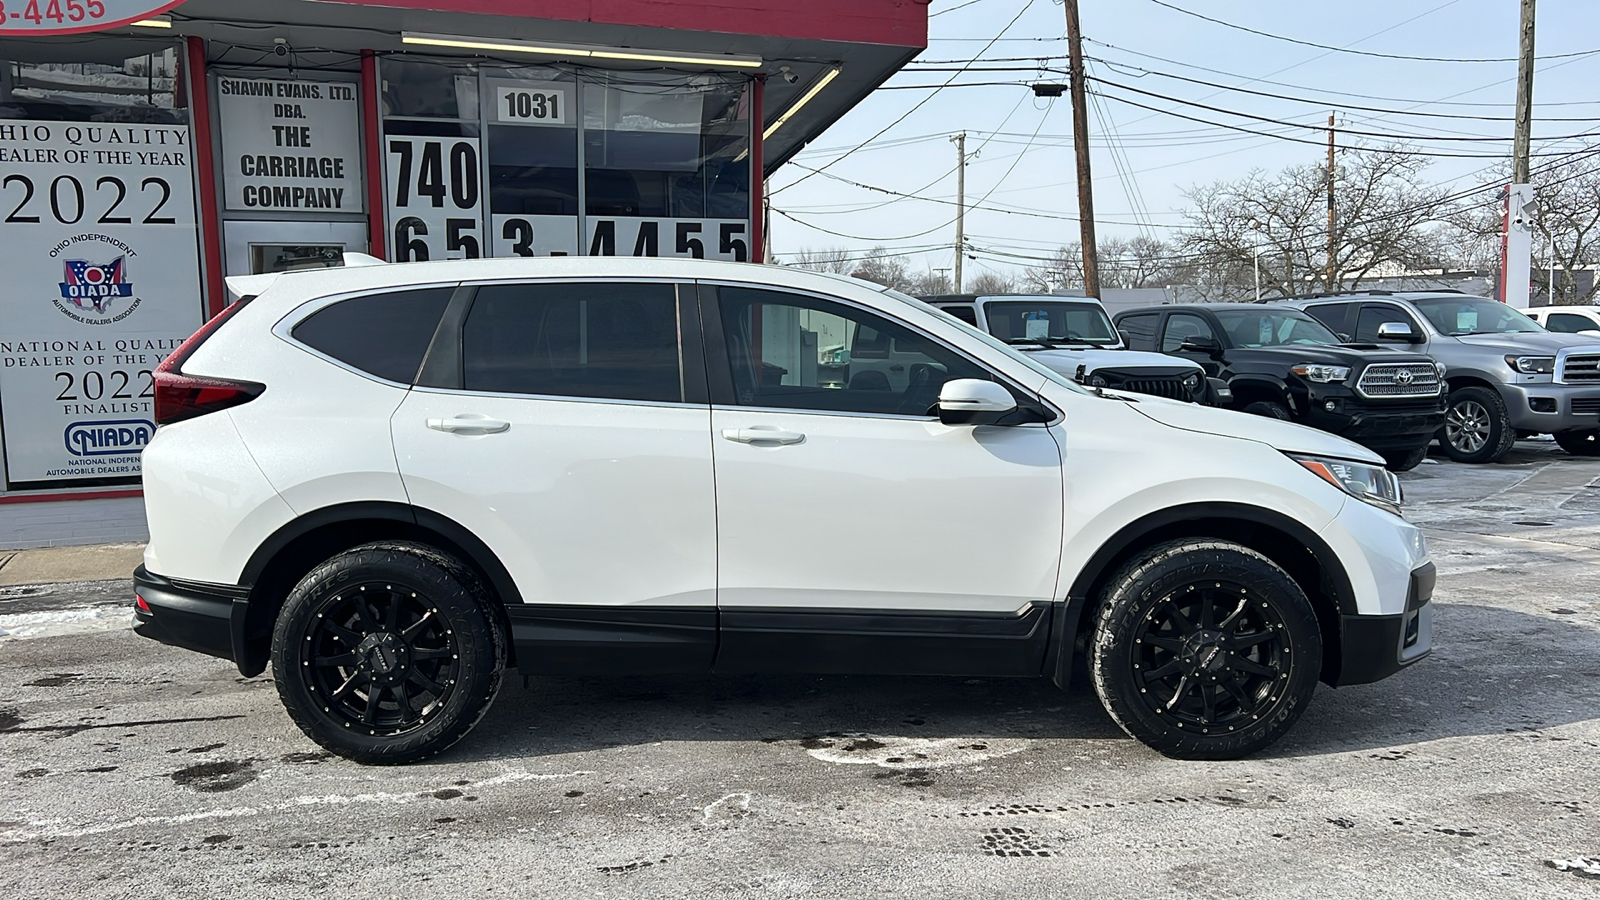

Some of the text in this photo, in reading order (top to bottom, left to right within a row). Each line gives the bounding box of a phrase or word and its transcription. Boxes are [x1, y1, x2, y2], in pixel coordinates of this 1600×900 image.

[221, 80, 355, 101] SHAWN EVANS. LTD.
[273, 103, 306, 119] DBA.
[504, 92, 559, 119] 1031
[0, 124, 187, 145] HIO QUALITY
[272, 125, 311, 148] THE
[0, 148, 186, 166] EALER OF THE YEAR
[240, 154, 344, 179] CARRIAGE
[389, 140, 478, 209] 740
[2, 173, 176, 225] 2022
[243, 185, 344, 208] COMPANY
[49, 233, 138, 259] OHIO INDEPENDENT
[68, 284, 121, 298] OIADA
[52, 297, 142, 326] AUTOMOBILE DEALERS ASSOCIATION
[0, 339, 187, 353] NATIONAL QUALIT
[4, 356, 75, 368] DEALER
[83, 355, 105, 366] OF
[113, 354, 147, 365] THE
[54, 369, 155, 401] 2022
[64, 402, 151, 415] FINALIST
[72, 427, 149, 453] NIADA
[108, 456, 141, 464] INDEPEN
[46, 468, 95, 477] AUTOMOBILE
[97, 466, 129, 474] DEALERS
